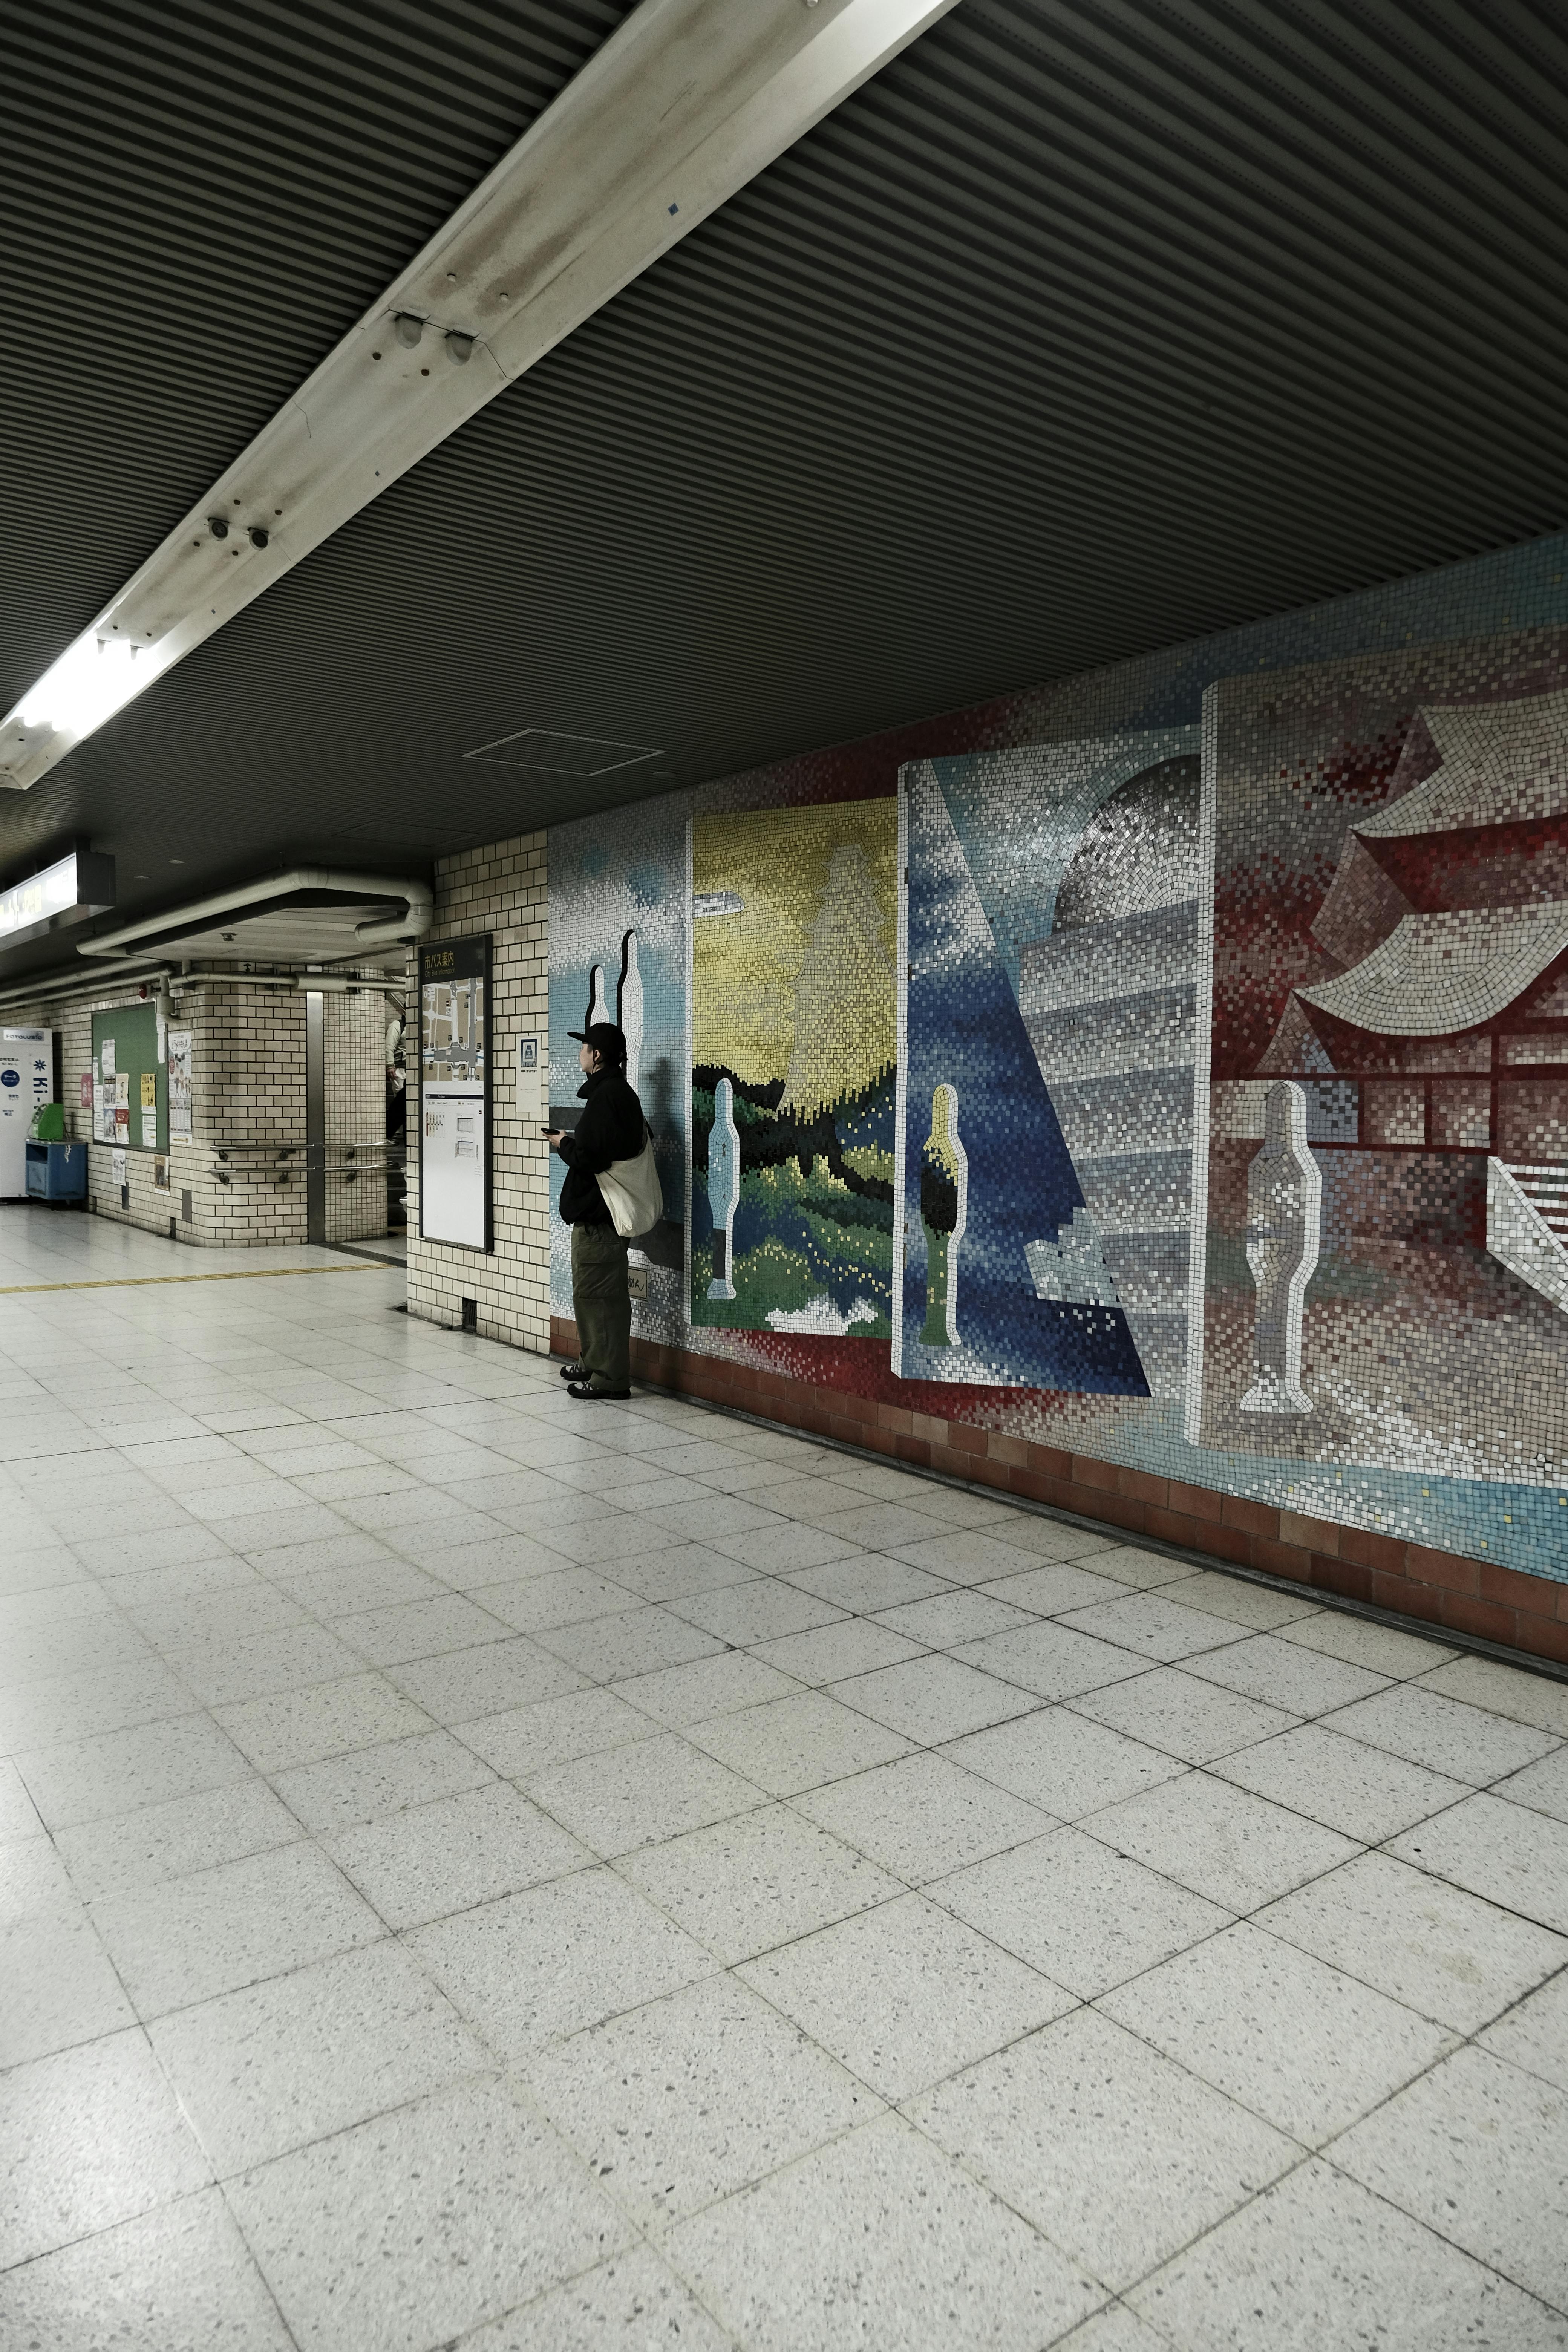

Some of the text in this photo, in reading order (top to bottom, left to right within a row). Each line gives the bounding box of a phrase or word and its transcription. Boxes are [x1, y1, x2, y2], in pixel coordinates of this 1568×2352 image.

[425, 951, 454, 969] 市バス案内
